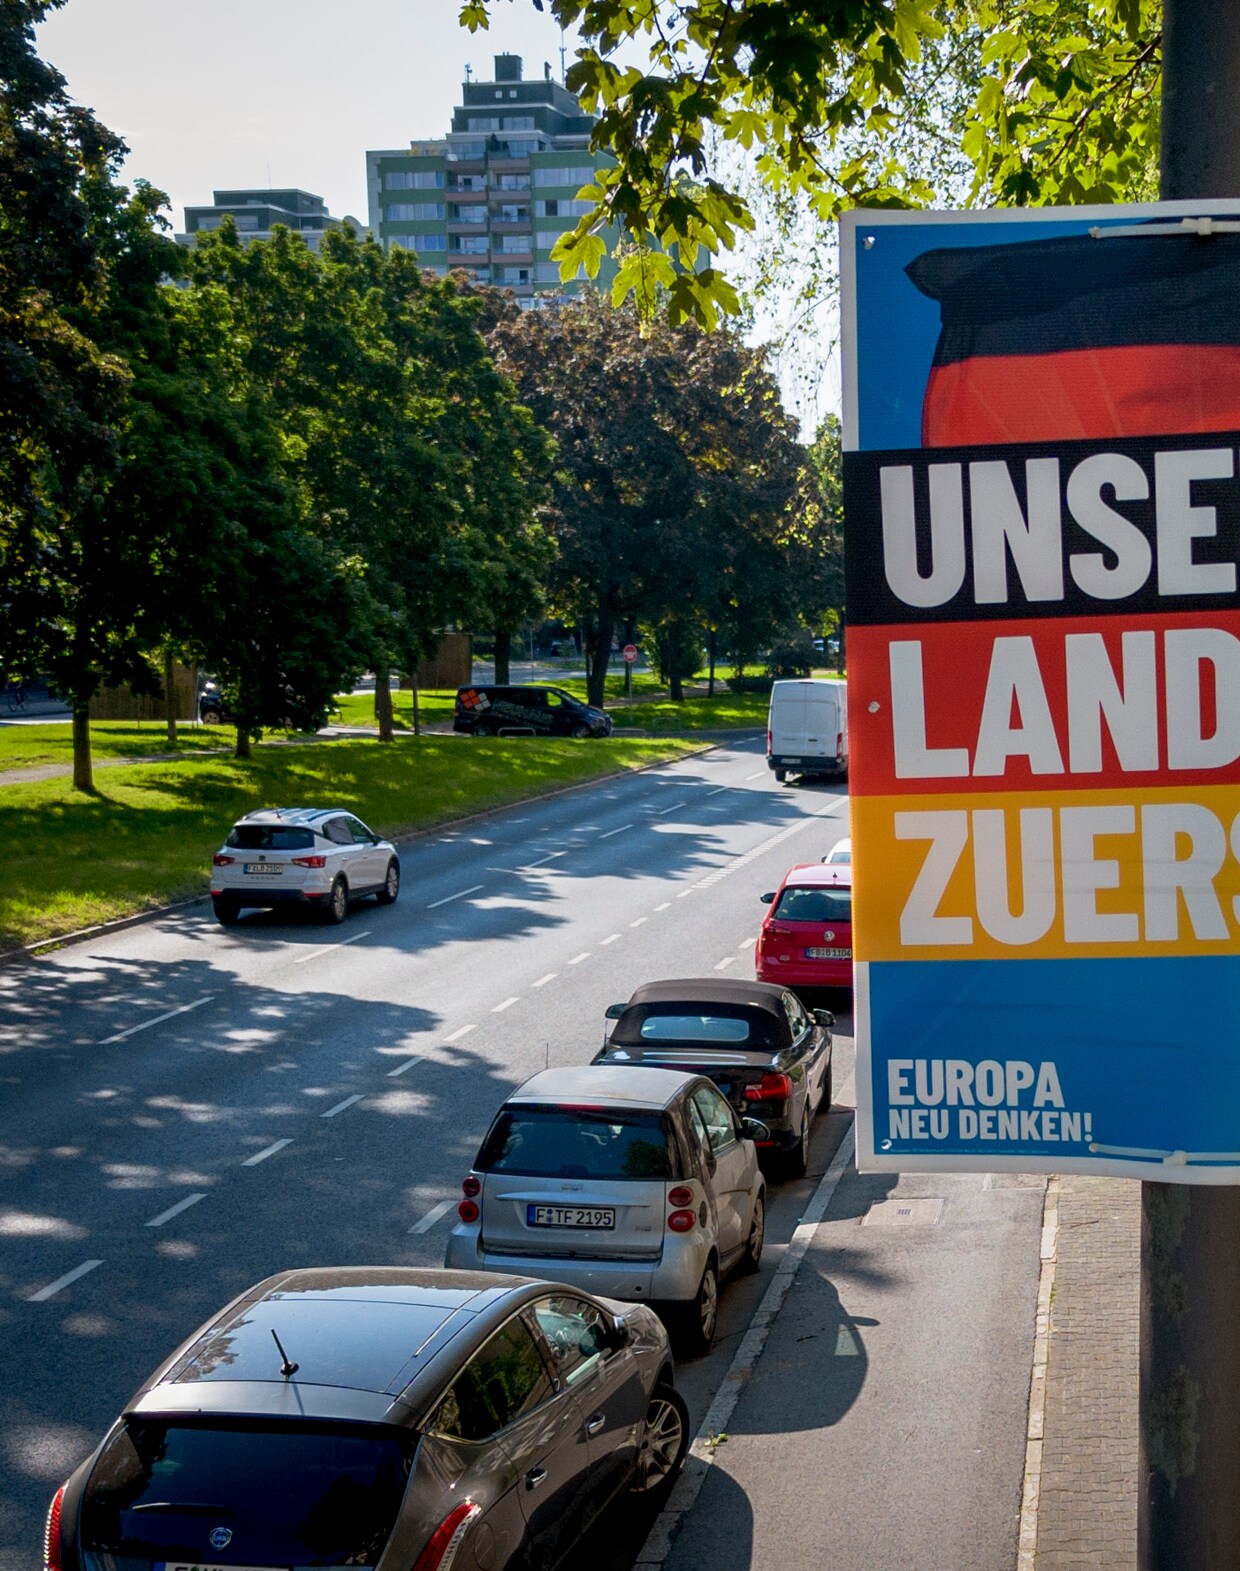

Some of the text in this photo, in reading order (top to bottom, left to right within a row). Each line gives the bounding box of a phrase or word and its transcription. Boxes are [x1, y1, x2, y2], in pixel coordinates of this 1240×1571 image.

[887, 1059, 1065, 1108] EUROPA
[888, 1108, 1093, 1143] NEU DENKEN!
[576, 1210, 612, 1226] 2195
